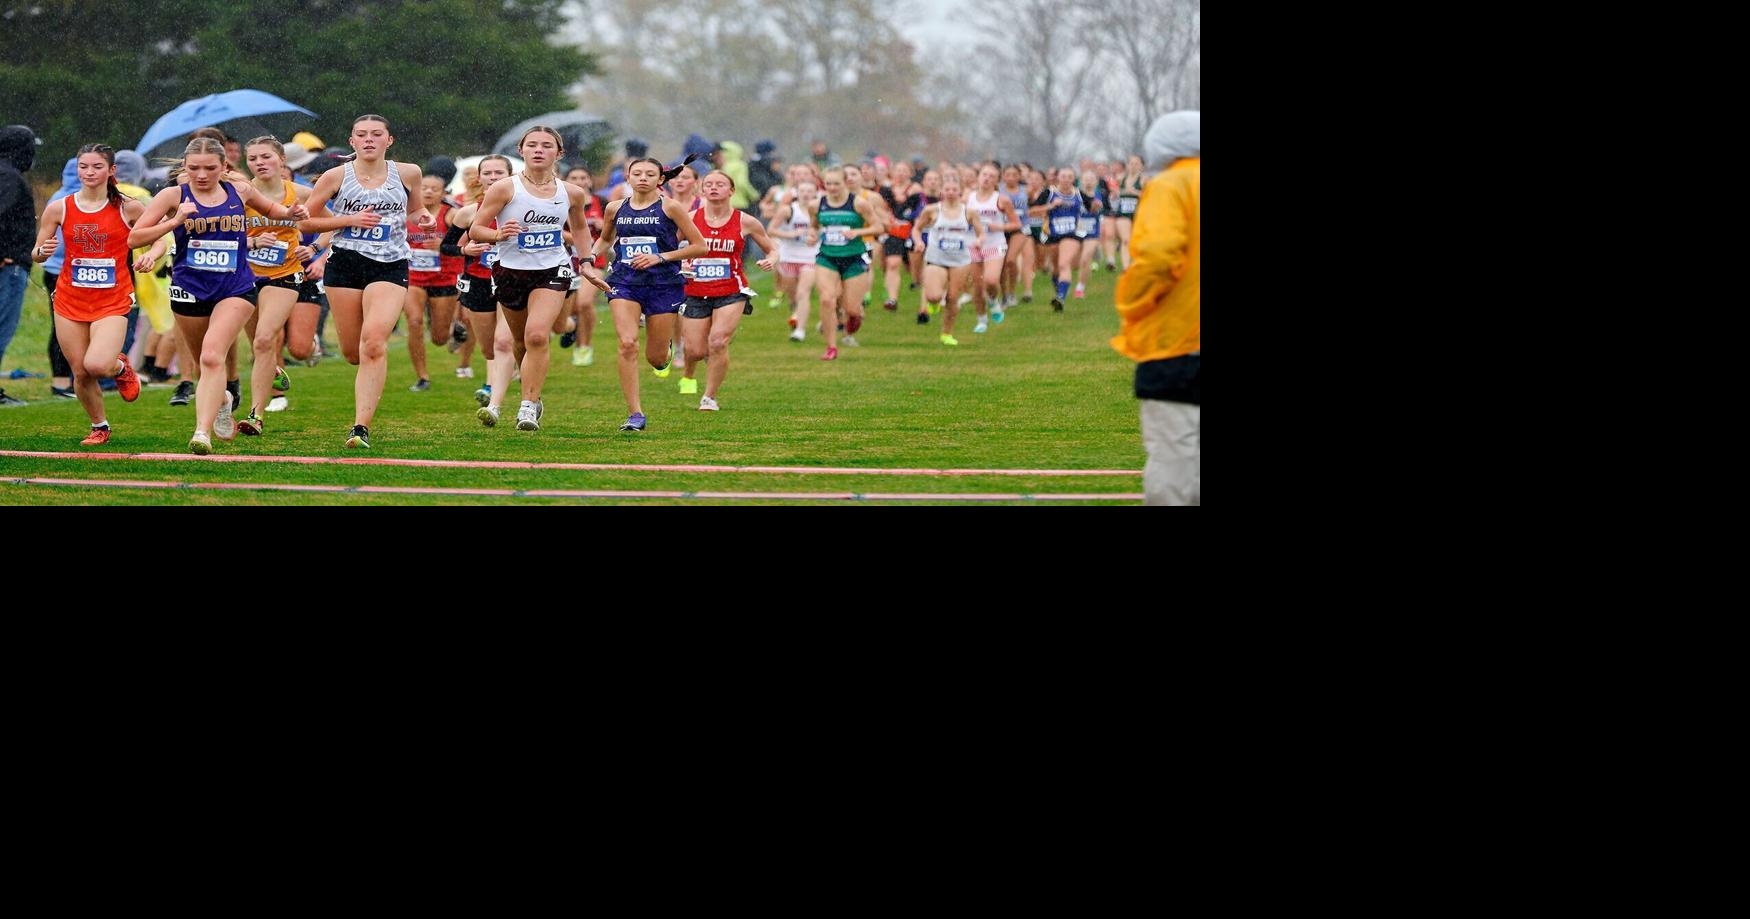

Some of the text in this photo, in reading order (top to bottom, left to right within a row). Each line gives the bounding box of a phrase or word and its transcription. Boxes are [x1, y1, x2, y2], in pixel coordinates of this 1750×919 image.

[343, 199, 403, 213] Warriors
[524, 209, 560, 225] Osage
[616, 216, 660, 225] FAIR GROVE
[184, 214, 245, 235] POTOSI
[351, 226, 383, 240] 979
[524, 233, 555, 247] 942
[626, 245, 653, 258] 849
[713, 239, 735, 252] CLAIR
[194, 250, 230, 266] 960
[248, 247, 280, 262] 855
[77, 268, 108, 282] 886
[698, 265, 725, 277] 988
